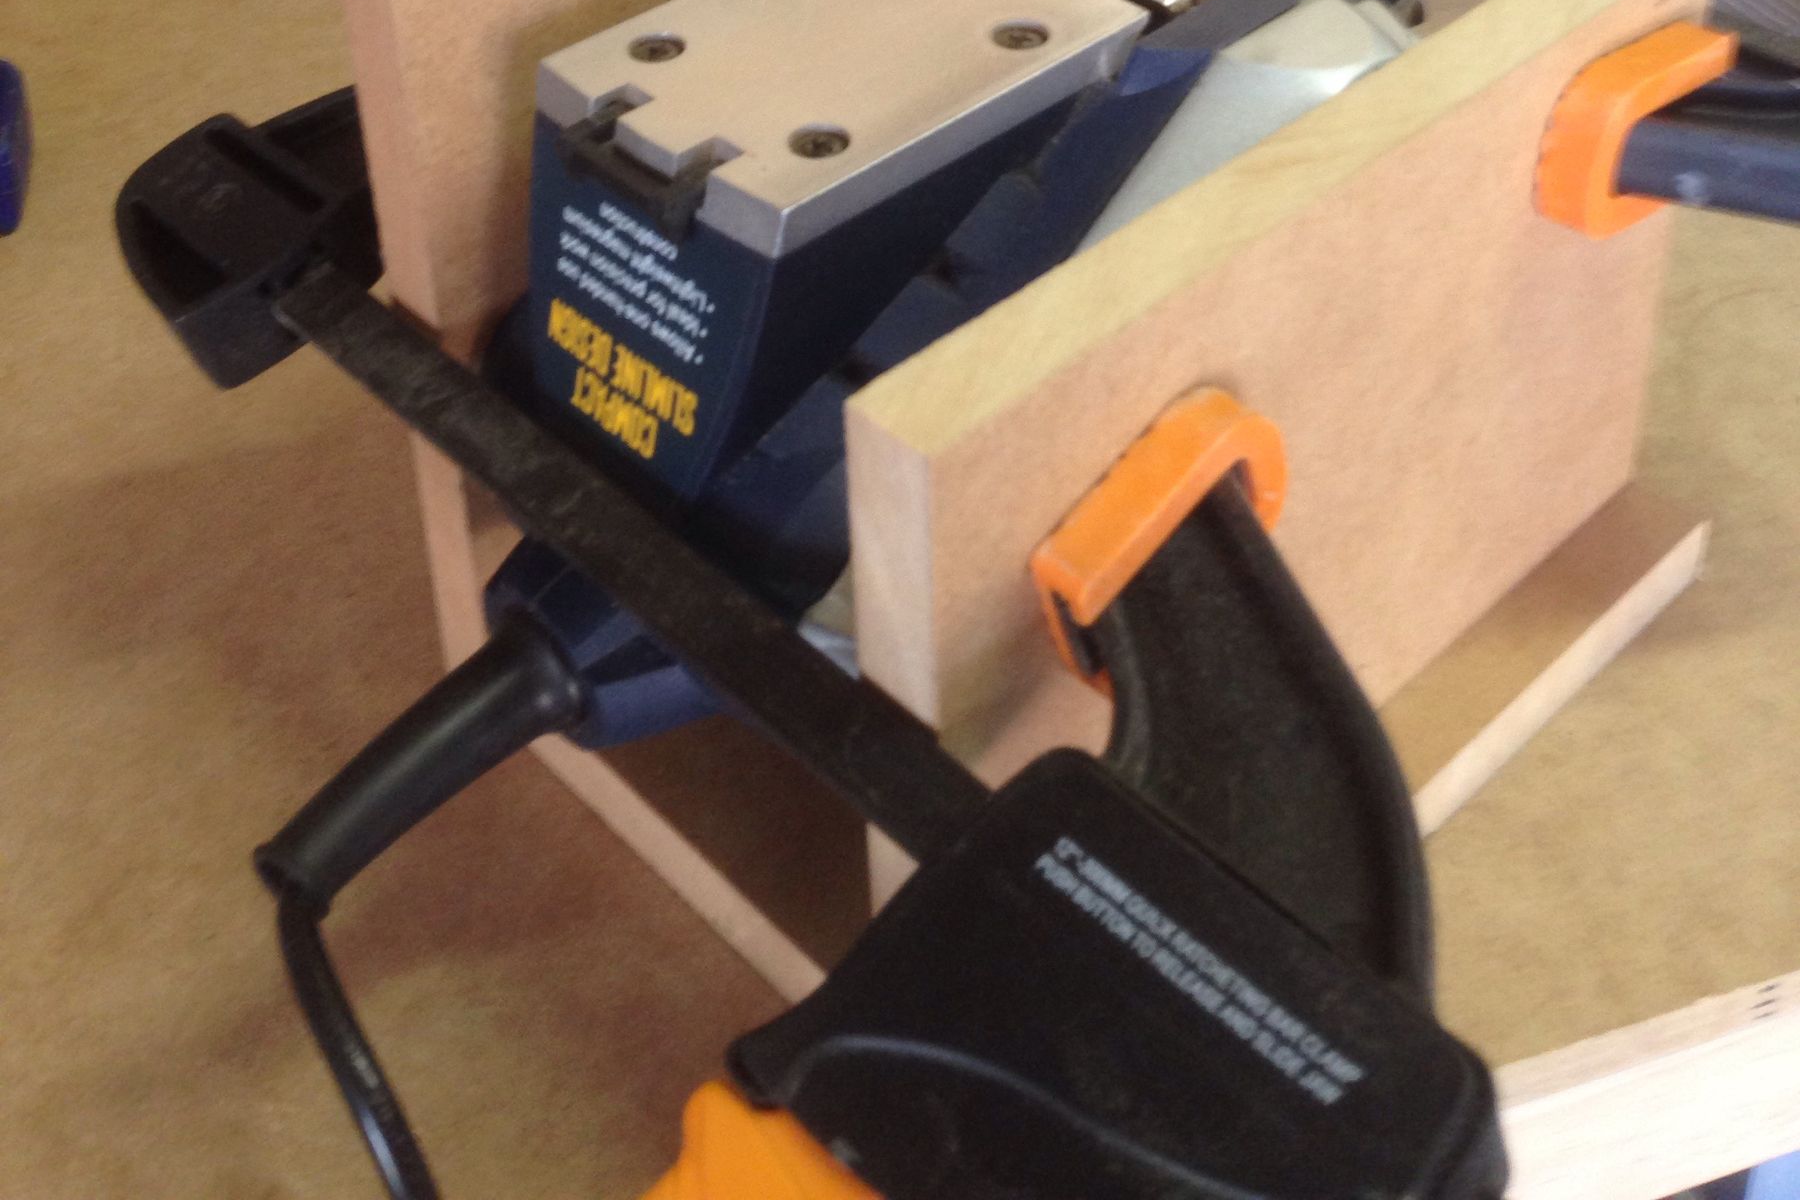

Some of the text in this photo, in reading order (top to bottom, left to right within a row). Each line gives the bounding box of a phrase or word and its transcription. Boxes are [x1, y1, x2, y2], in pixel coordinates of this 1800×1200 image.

[556, 255, 583, 282] use
[588, 250, 649, 299] precision
[547, 297, 698, 437] SLIMLINE DESIGN
[570, 366, 660, 460] COMPACT
[1071, 884, 1138, 942] BUTTON
[1130, 929, 1158, 959] TO
[1149, 947, 1227, 1014] RELEASE
[1215, 1004, 1259, 1041] AND
[1298, 1032, 1365, 1083] CLAMP
